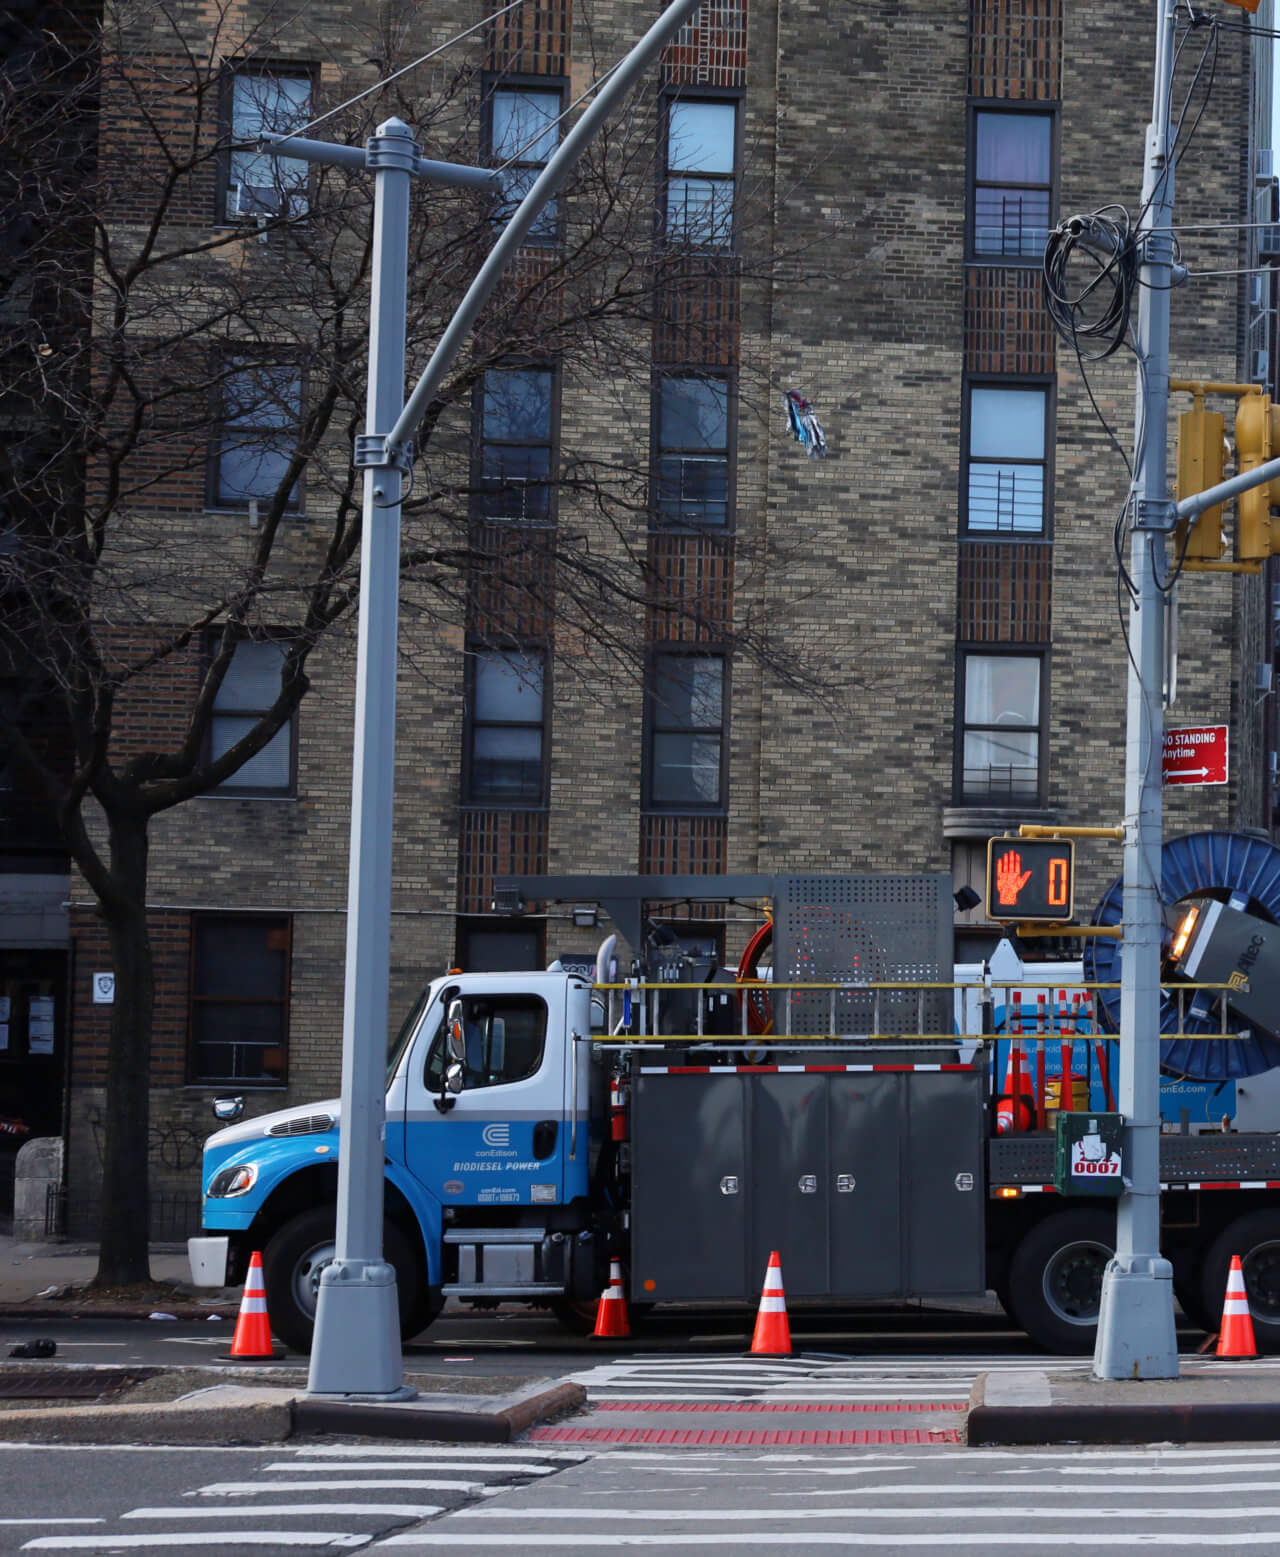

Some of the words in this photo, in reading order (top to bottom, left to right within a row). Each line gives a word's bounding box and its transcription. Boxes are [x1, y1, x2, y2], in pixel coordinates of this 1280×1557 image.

[1175, 732, 1216, 745] STANDING
[1162, 748, 1196, 760] Anytime
[1048, 858, 1067, 905] 0
[1236, 935, 1264, 976] Altec
[1160, 1085, 1206, 1094] onEd.com
[453, 1161, 503, 1172] BIODIESEL
[505, 1161, 540, 1171] POWER
[1074, 1162, 1119, 1174] 0007
